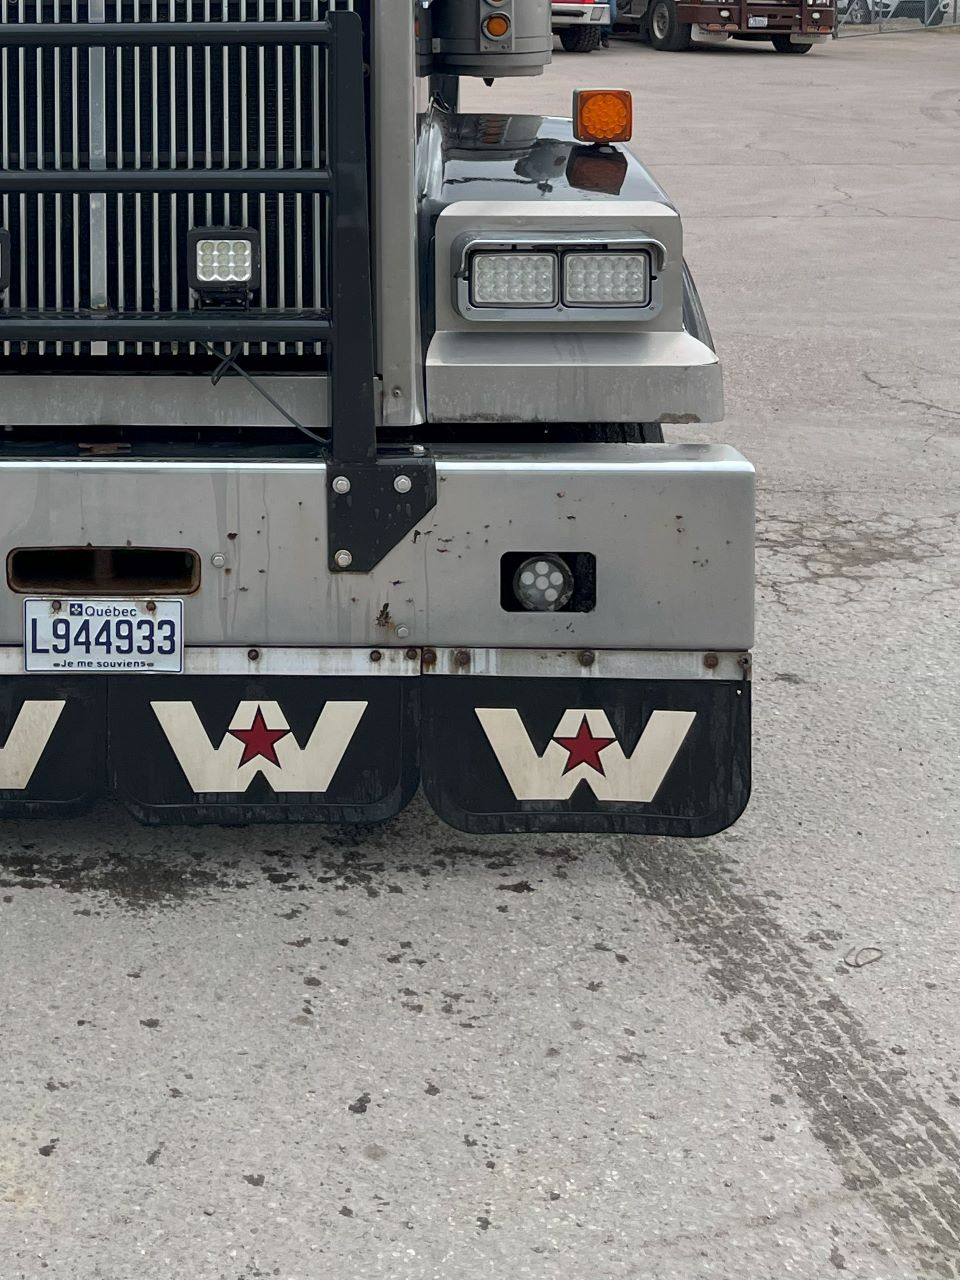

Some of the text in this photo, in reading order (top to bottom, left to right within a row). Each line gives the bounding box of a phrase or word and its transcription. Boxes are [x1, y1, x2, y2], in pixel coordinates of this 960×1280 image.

[31, 618, 176, 655] L944933
[85, 606, 137, 617] Québec
[150, 700, 368, 793] W
[474, 708, 697, 802] W
